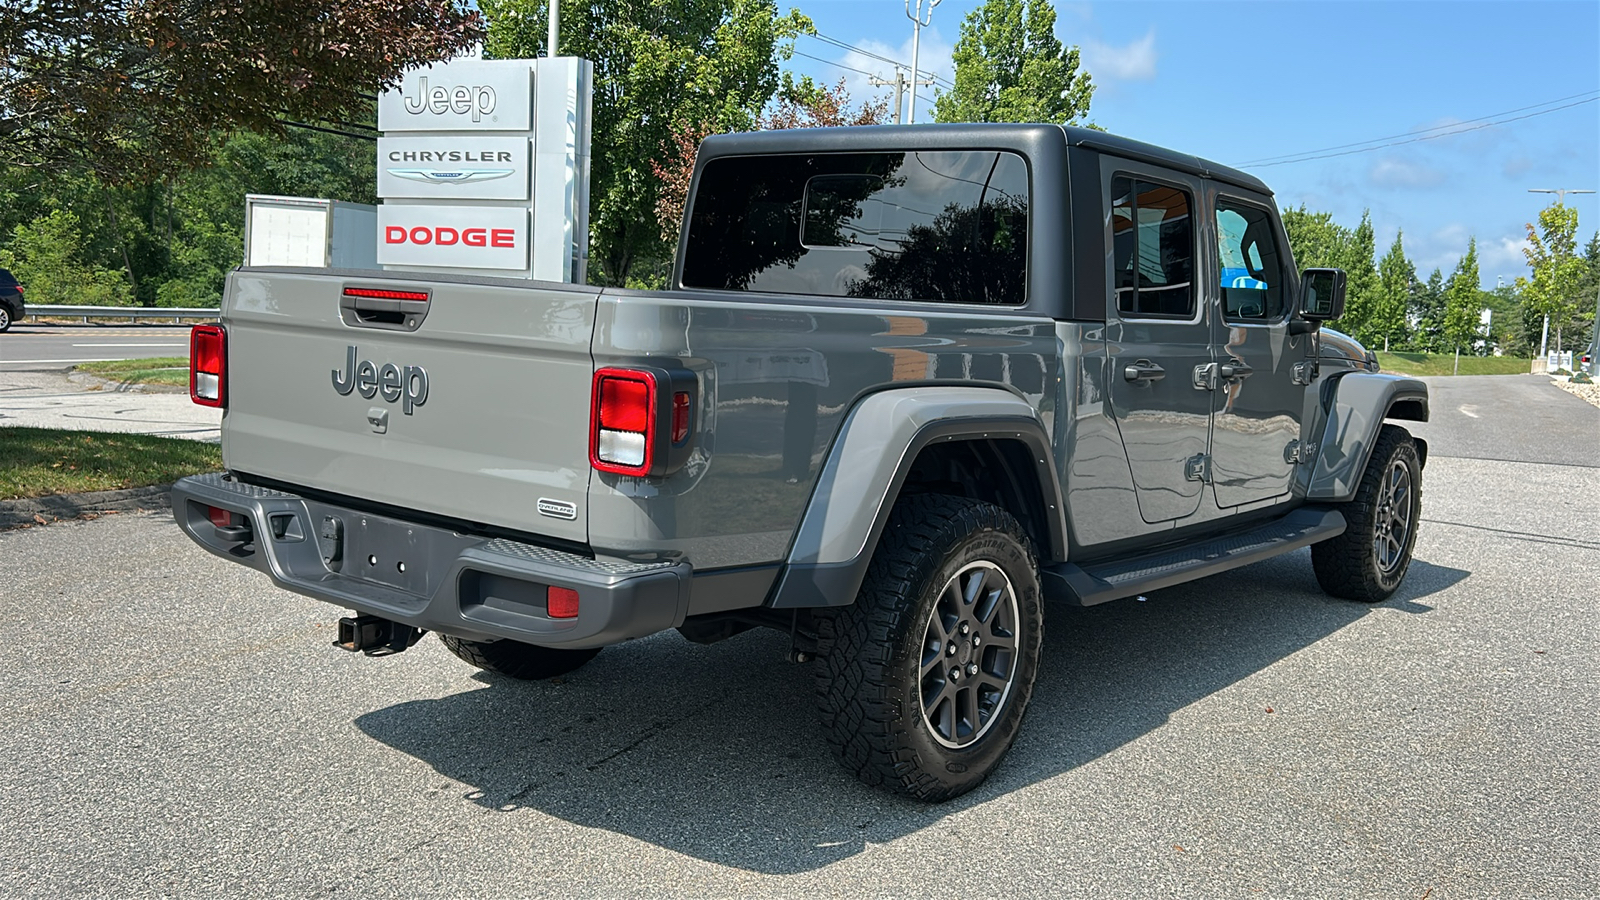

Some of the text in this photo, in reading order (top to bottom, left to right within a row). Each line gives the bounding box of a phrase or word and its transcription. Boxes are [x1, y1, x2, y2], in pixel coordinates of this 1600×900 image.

[404, 76, 497, 122] Jeep
[388, 151, 512, 163] CHRYSLER
[385, 226, 515, 248] DODGE
[331, 345, 429, 416] Jeep
[538, 503, 574, 514] OVERLAND
